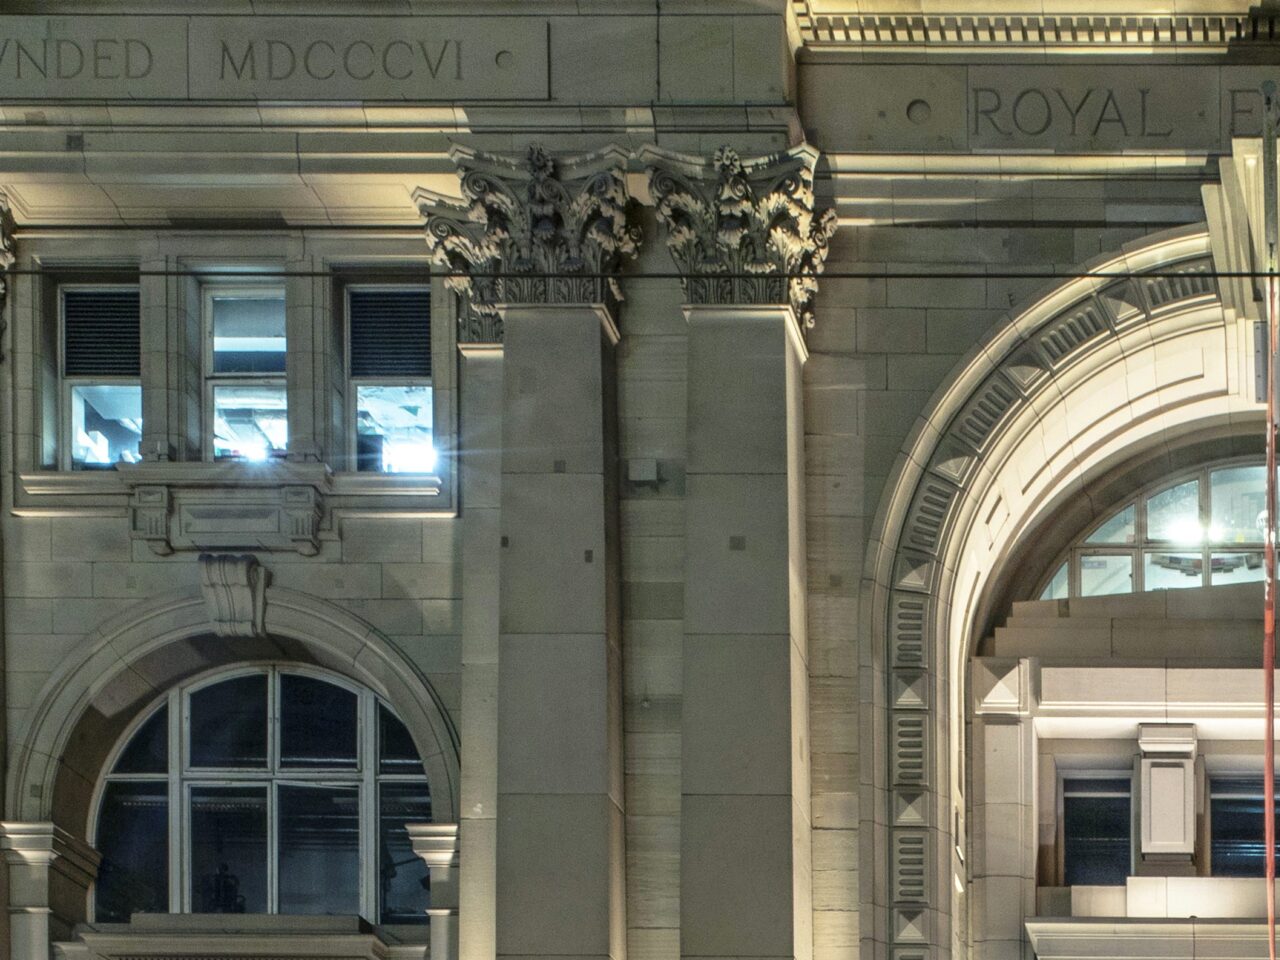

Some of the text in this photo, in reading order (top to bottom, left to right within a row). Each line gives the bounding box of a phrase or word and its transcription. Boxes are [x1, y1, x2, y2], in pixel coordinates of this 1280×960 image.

[0, 39, 465, 80] NDED MDCCCVI
[971, 88, 1173, 137] ROYAL
